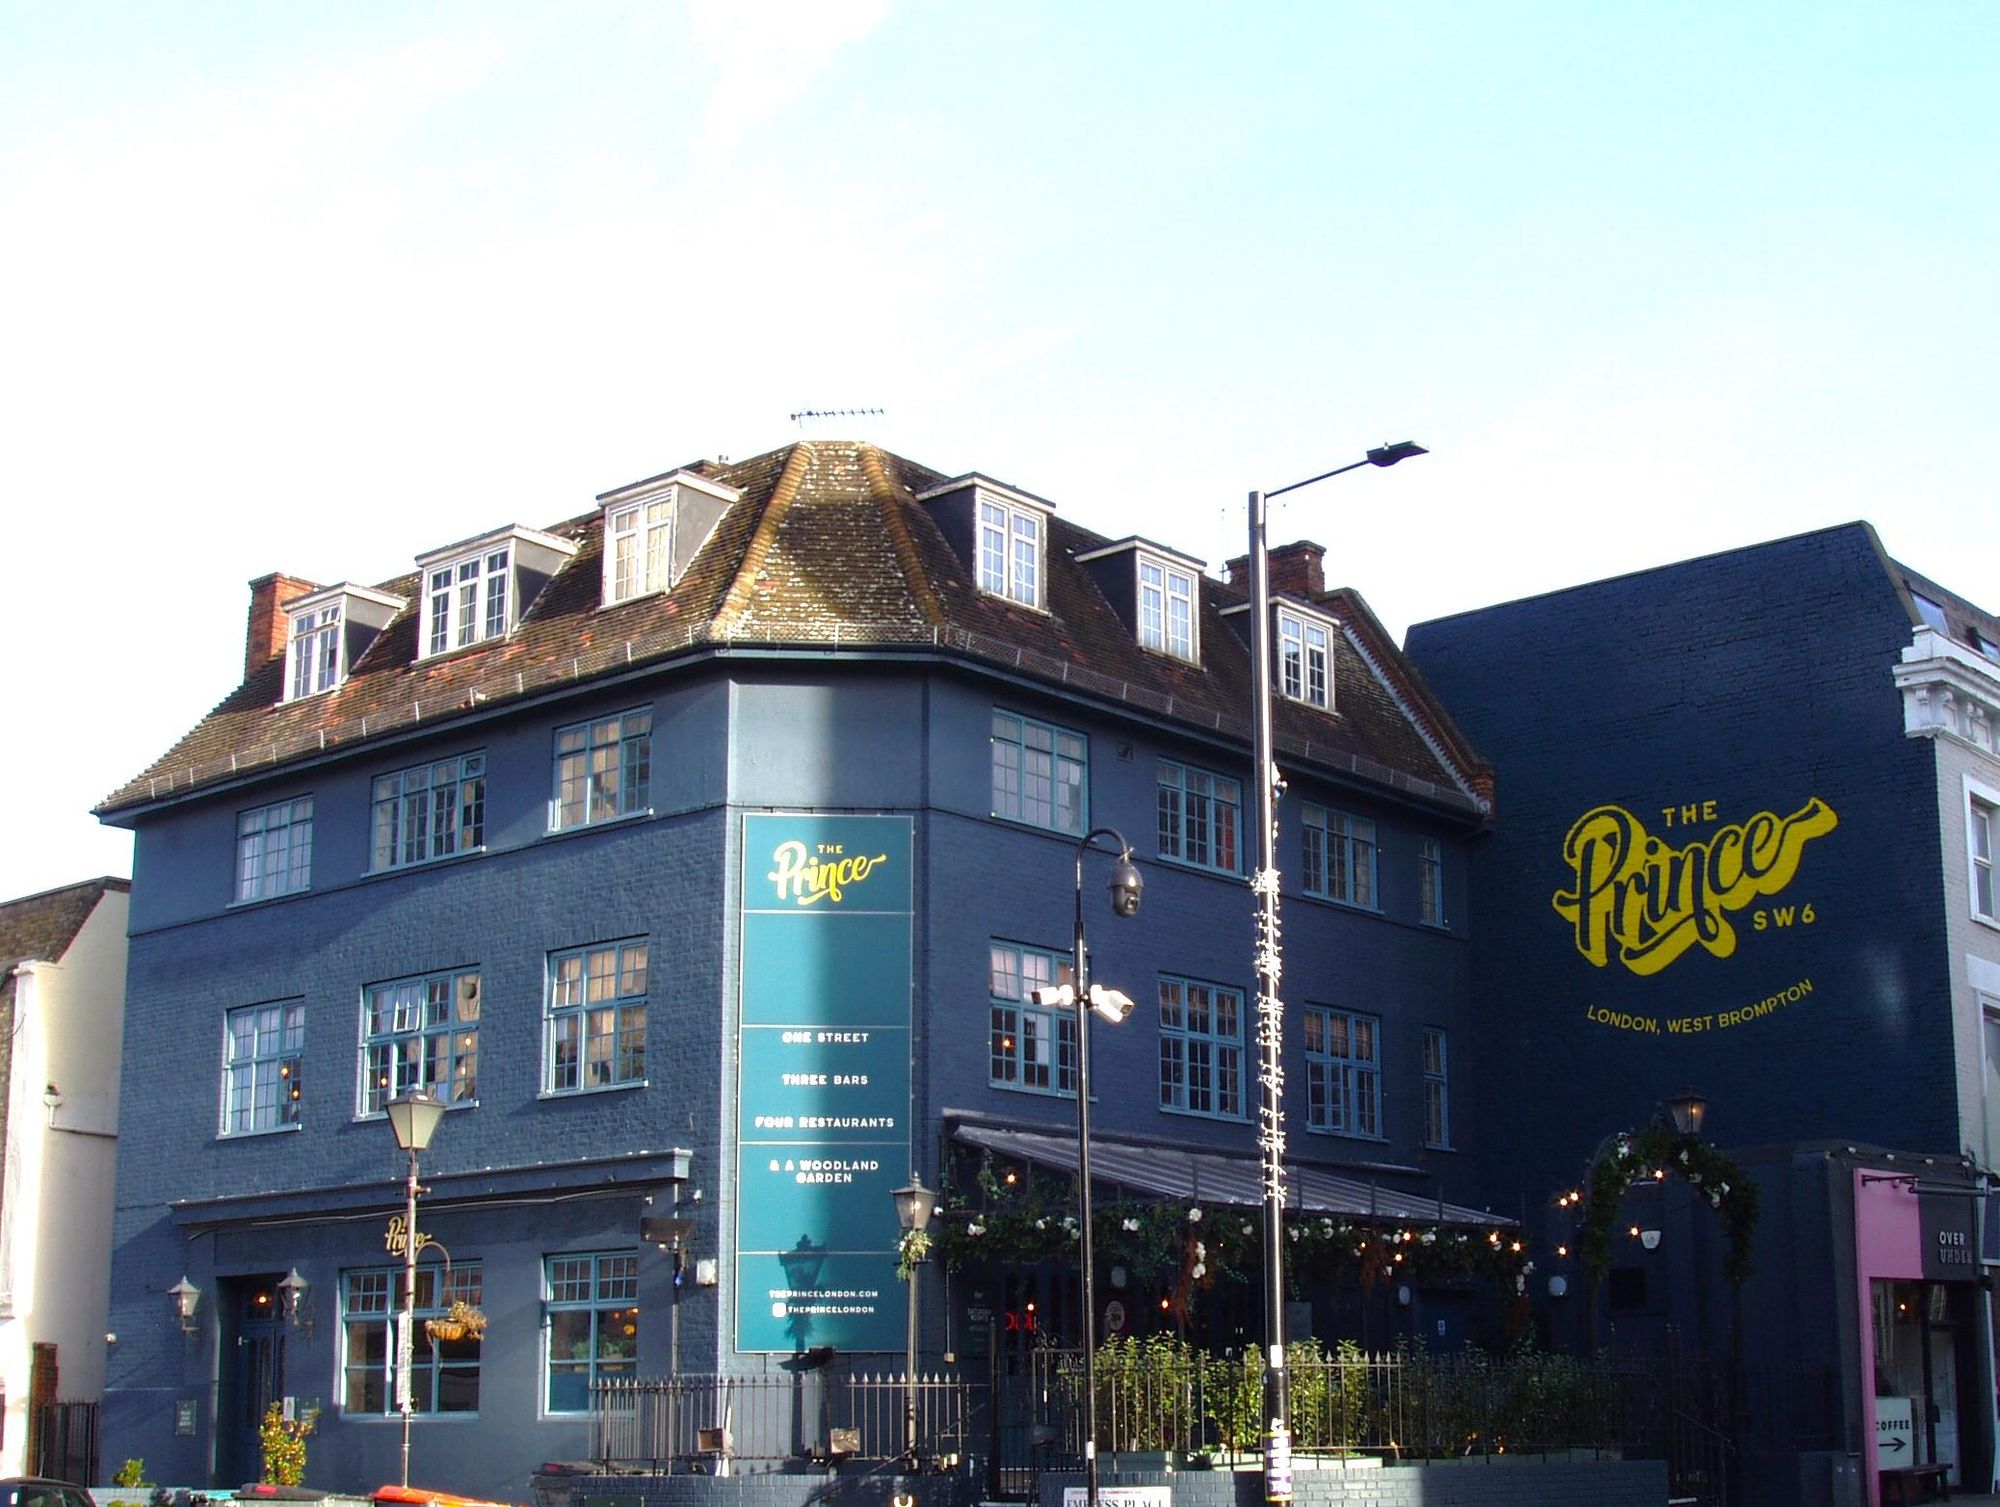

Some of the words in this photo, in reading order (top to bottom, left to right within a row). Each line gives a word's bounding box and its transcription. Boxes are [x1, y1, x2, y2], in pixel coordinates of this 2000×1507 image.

[1661, 801, 1717, 827] THE
[818, 844, 843, 854] THE
[767, 840, 887, 905] Prince
[1552, 796, 1839, 976] Prince
[1586, 1004, 1660, 1035] LONDON,
[1667, 1015, 1713, 1033] WEST
[1718, 978, 1814, 1029] BROMPTON
[782, 1031, 812, 1043] ONE
[817, 1032, 869, 1043] STREET
[782, 1074, 827, 1085] THREE
[833, 1075, 868, 1085] BARS
[755, 1116, 794, 1128] FOUR
[799, 1116, 894, 1128] RESTAURANTS
[784, 1159, 795, 1171] A
[799, 1159, 879, 1171] WOODLAND
[795, 1172, 852, 1183] GARDEN
[1939, 1231, 1965, 1246] OVER
[1939, 1248, 1972, 1264] UNDER
